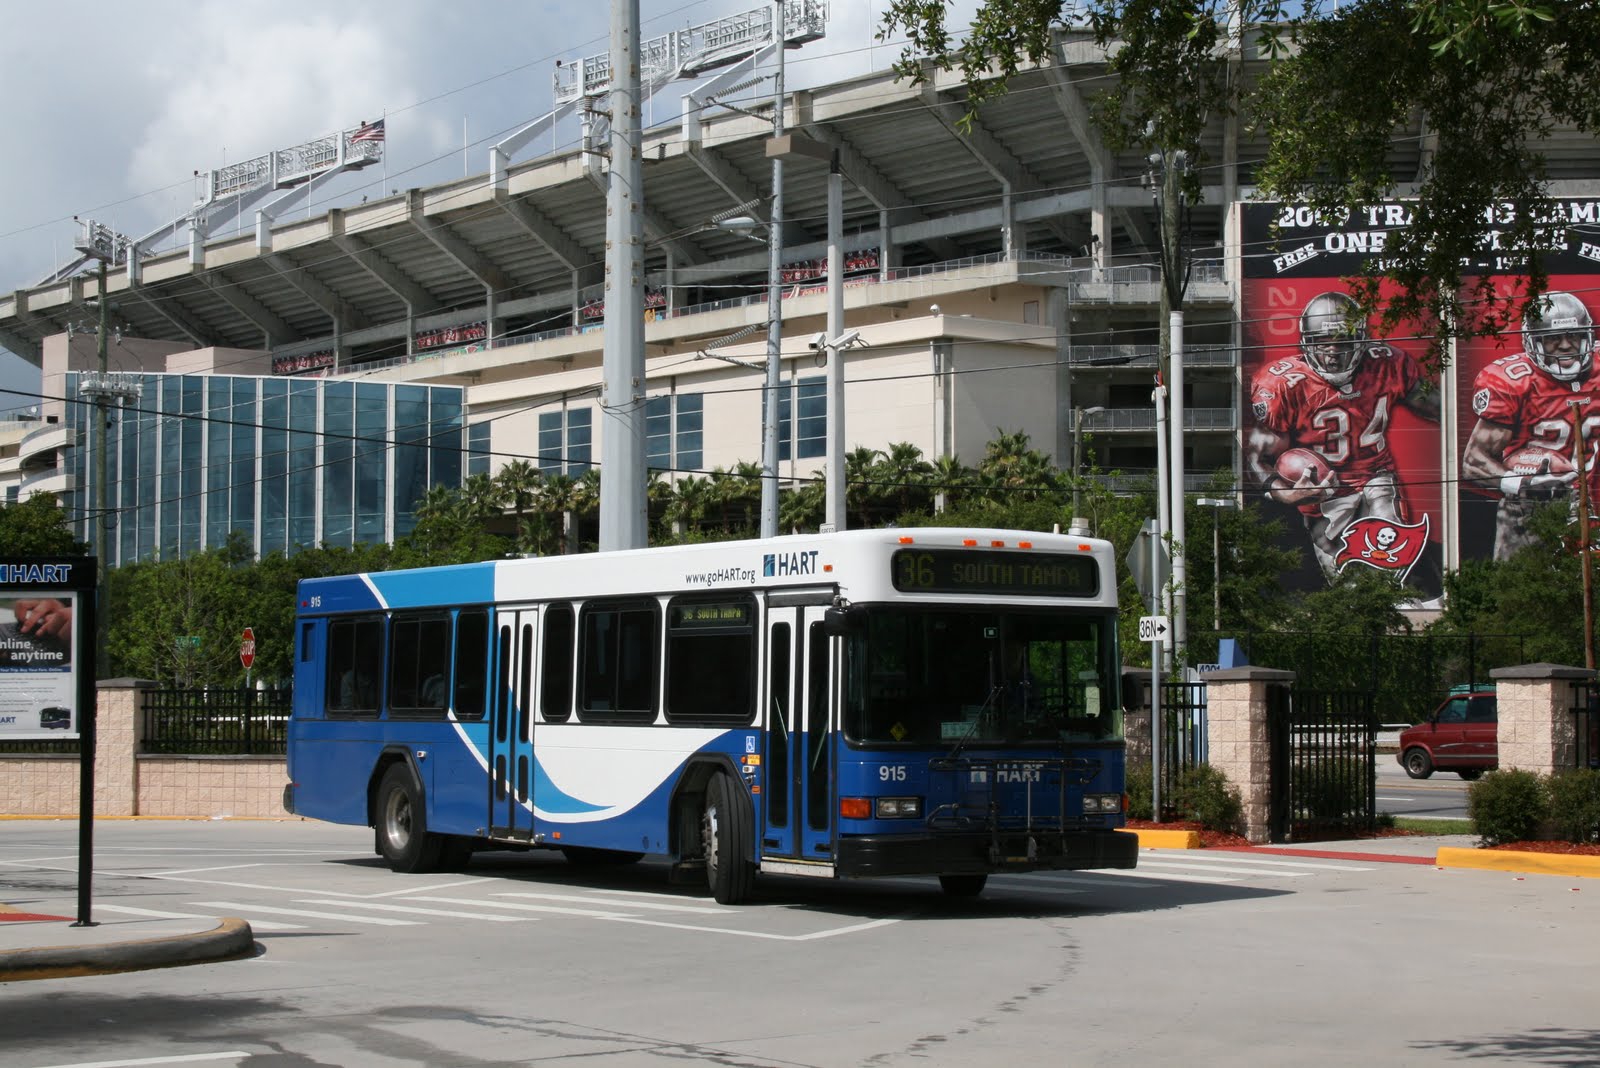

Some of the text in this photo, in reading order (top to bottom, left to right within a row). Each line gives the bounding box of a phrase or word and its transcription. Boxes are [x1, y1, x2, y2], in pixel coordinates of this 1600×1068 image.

[1325, 232, 1387, 253] ONE
[1273, 243, 1317, 272] FREE
[1312, 396, 1389, 463] 34
[778, 551, 818, 576] HART
[899, 553, 1080, 586] 36 SOUTH TAMPA
[9, 564, 72, 583] HART
[685, 568, 755, 586] www.goHART.org
[311, 596, 321, 607] 915
[697, 608, 718, 620] SOUTH
[720, 607, 741, 619] TAMPA
[1140, 620, 1156, 638] 36N
[11, 649, 63, 663] anytime
[241, 640, 254, 656] STOP
[879, 765, 906, 782] 915
